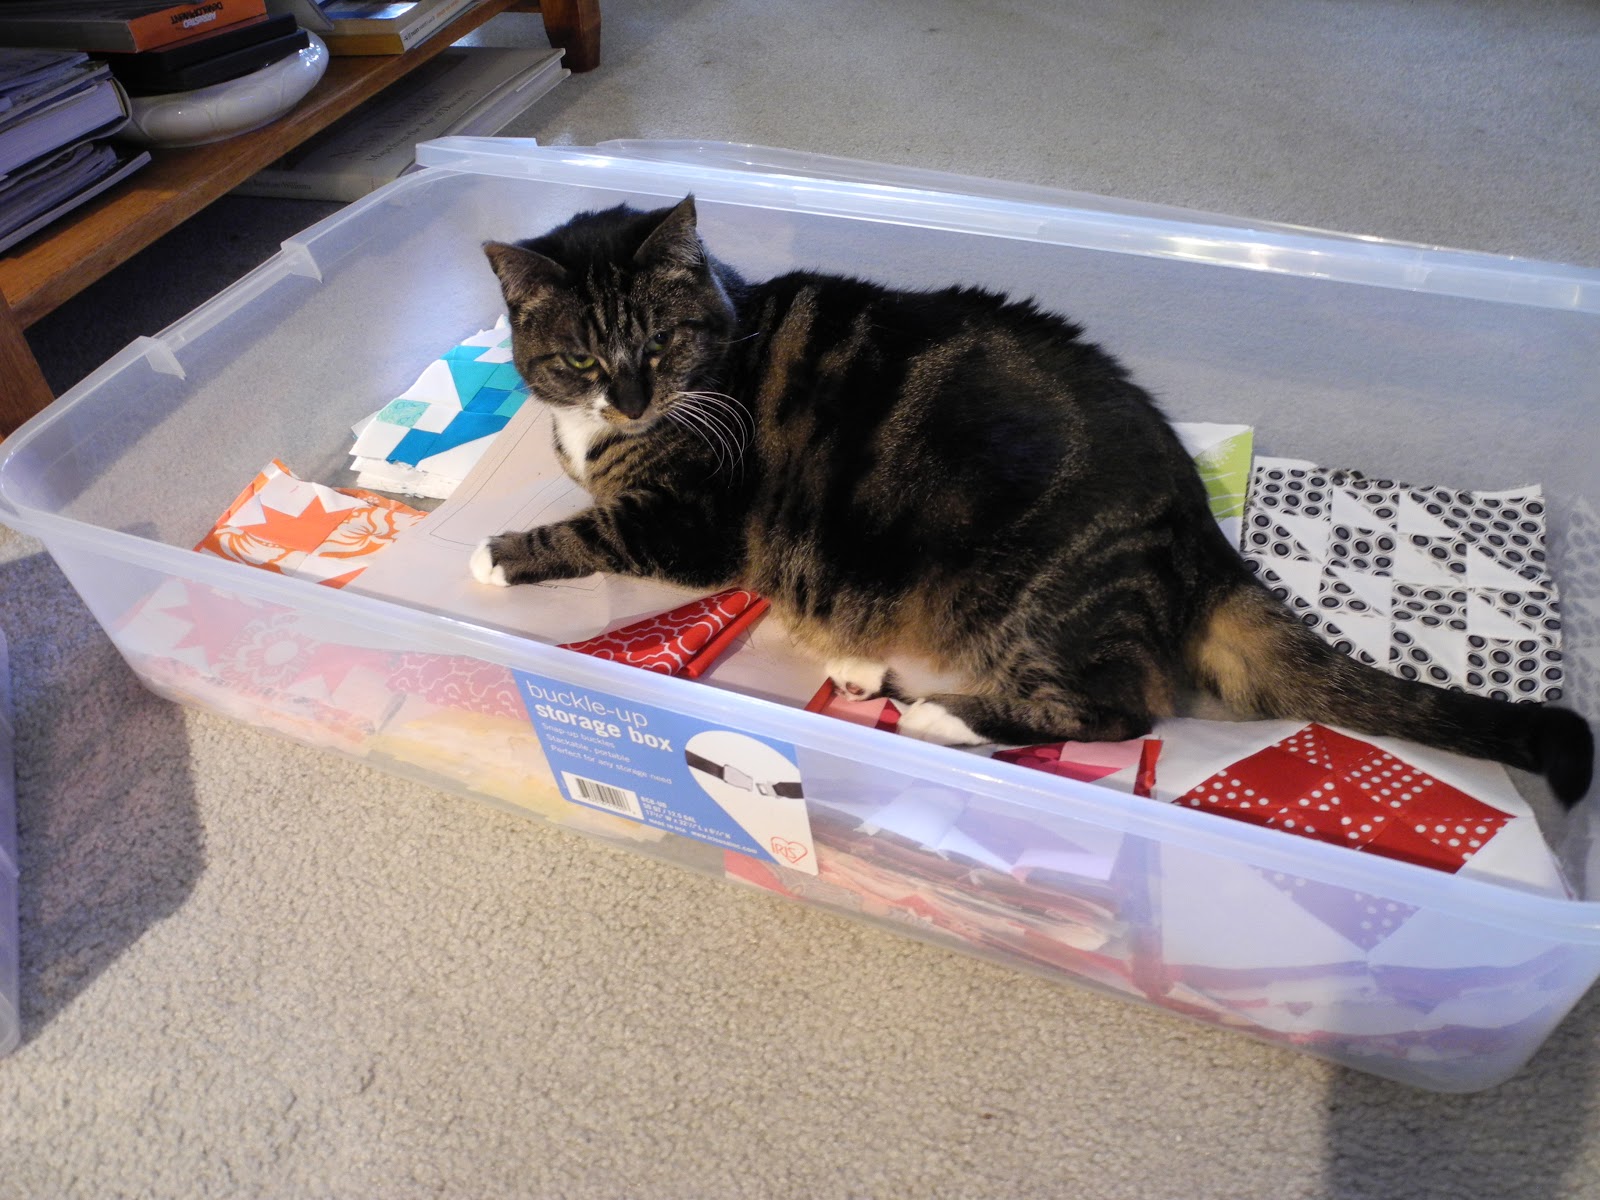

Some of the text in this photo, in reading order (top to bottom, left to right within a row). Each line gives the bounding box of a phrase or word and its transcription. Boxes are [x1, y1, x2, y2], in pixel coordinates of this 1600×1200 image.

[526, 680, 648, 728] buckle-up
[534, 703, 673, 752] storage box
[541, 722, 616, 748] Snap-up buckles
[550, 744, 673, 784] Perfect for any storage need
[594, 747, 631, 762] portable
[771, 840, 799, 860] IRIS
